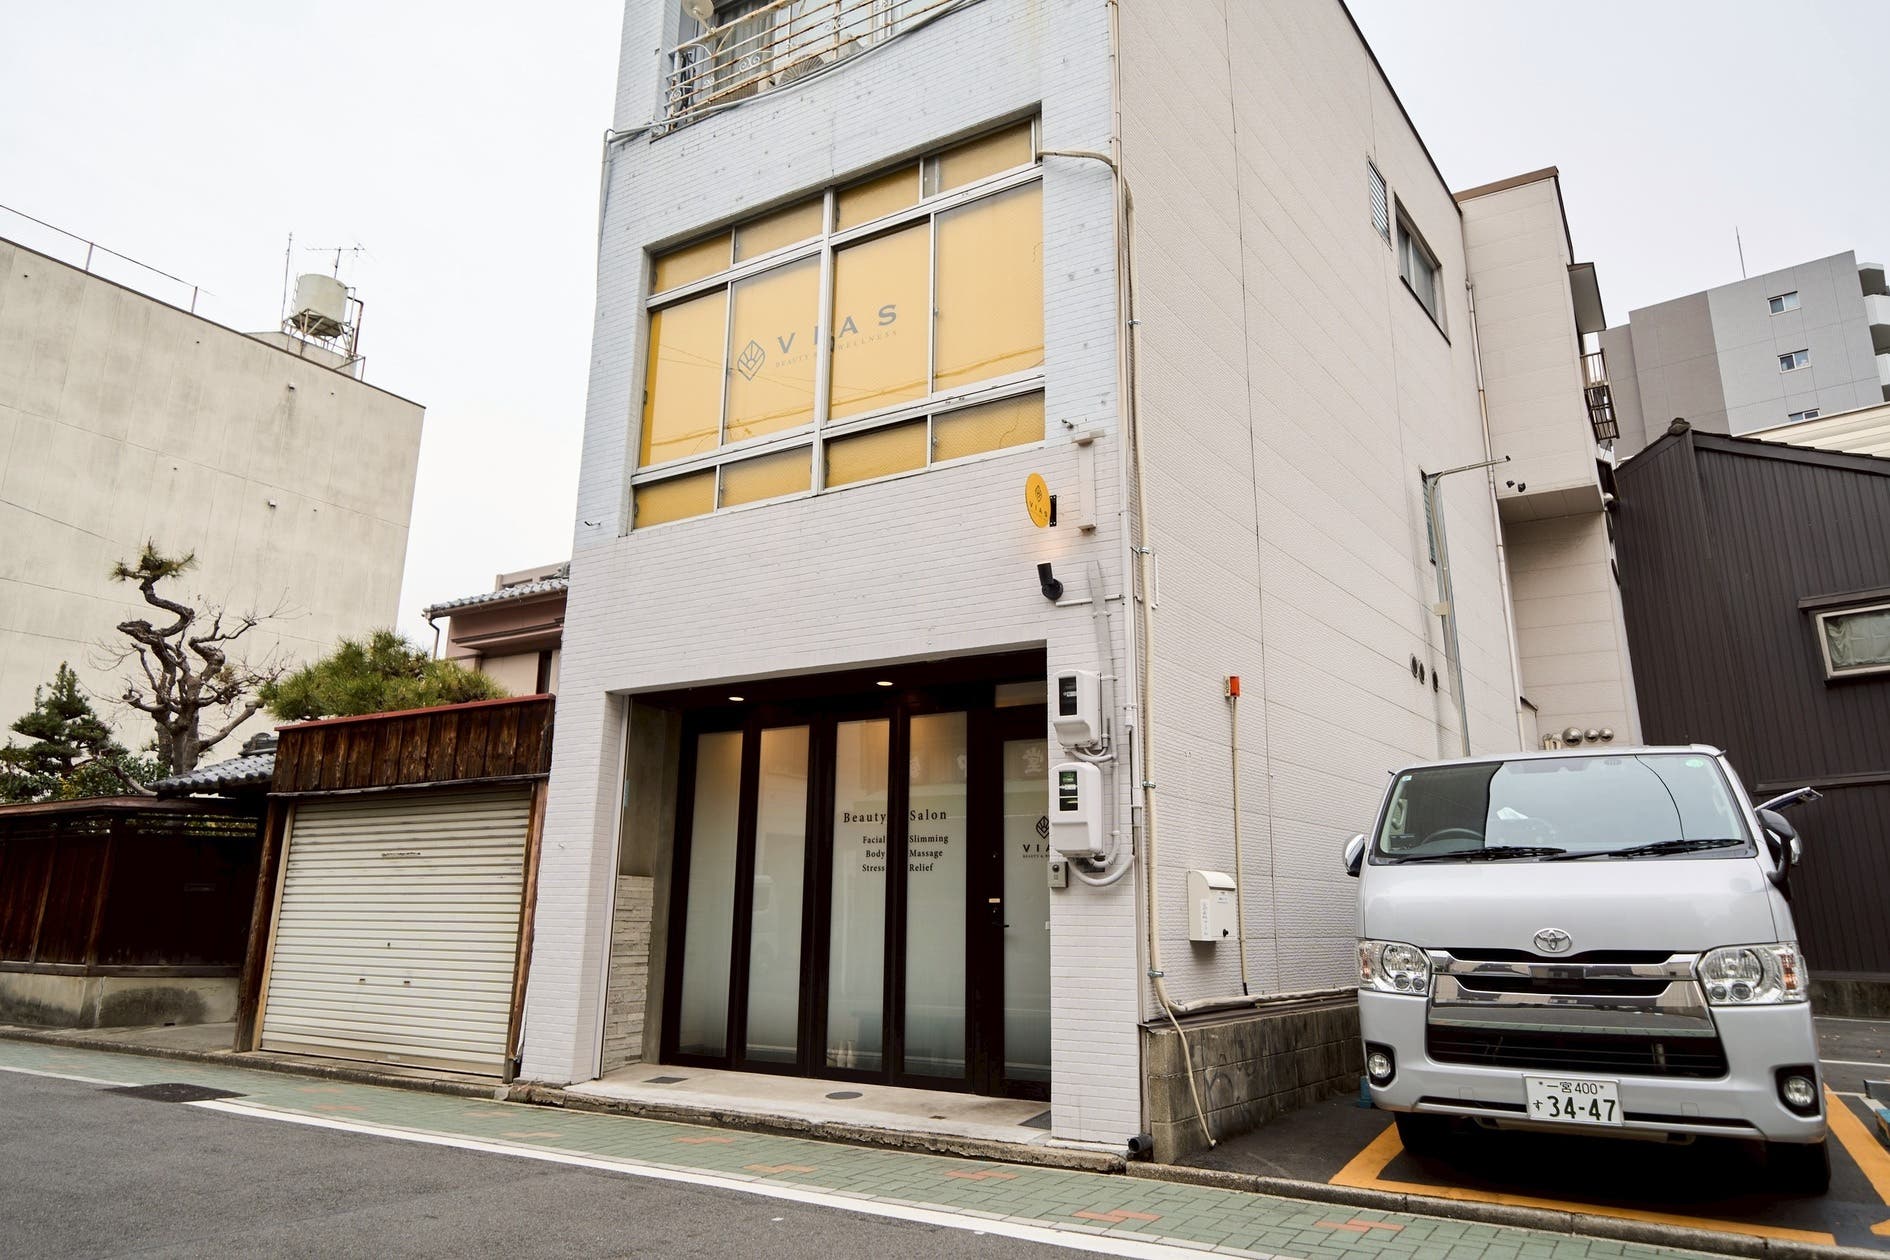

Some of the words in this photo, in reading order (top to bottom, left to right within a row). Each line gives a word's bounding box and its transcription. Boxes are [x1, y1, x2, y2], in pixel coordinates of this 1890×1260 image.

[777, 304, 897, 354] VIAS
[843, 812, 887, 824] Beauty
[909, 810, 948, 821] Salon
[862, 835, 886, 844] Facial
[909, 834, 949, 845] Slimming
[865, 849, 886, 860] Body
[909, 849, 944, 859] Massage
[862, 863, 886, 872] Stress
[909, 862, 934, 872] Relief
[1533, 1100, 1543, 1111] す
[1547, 1095, 1616, 1122] 34-47
